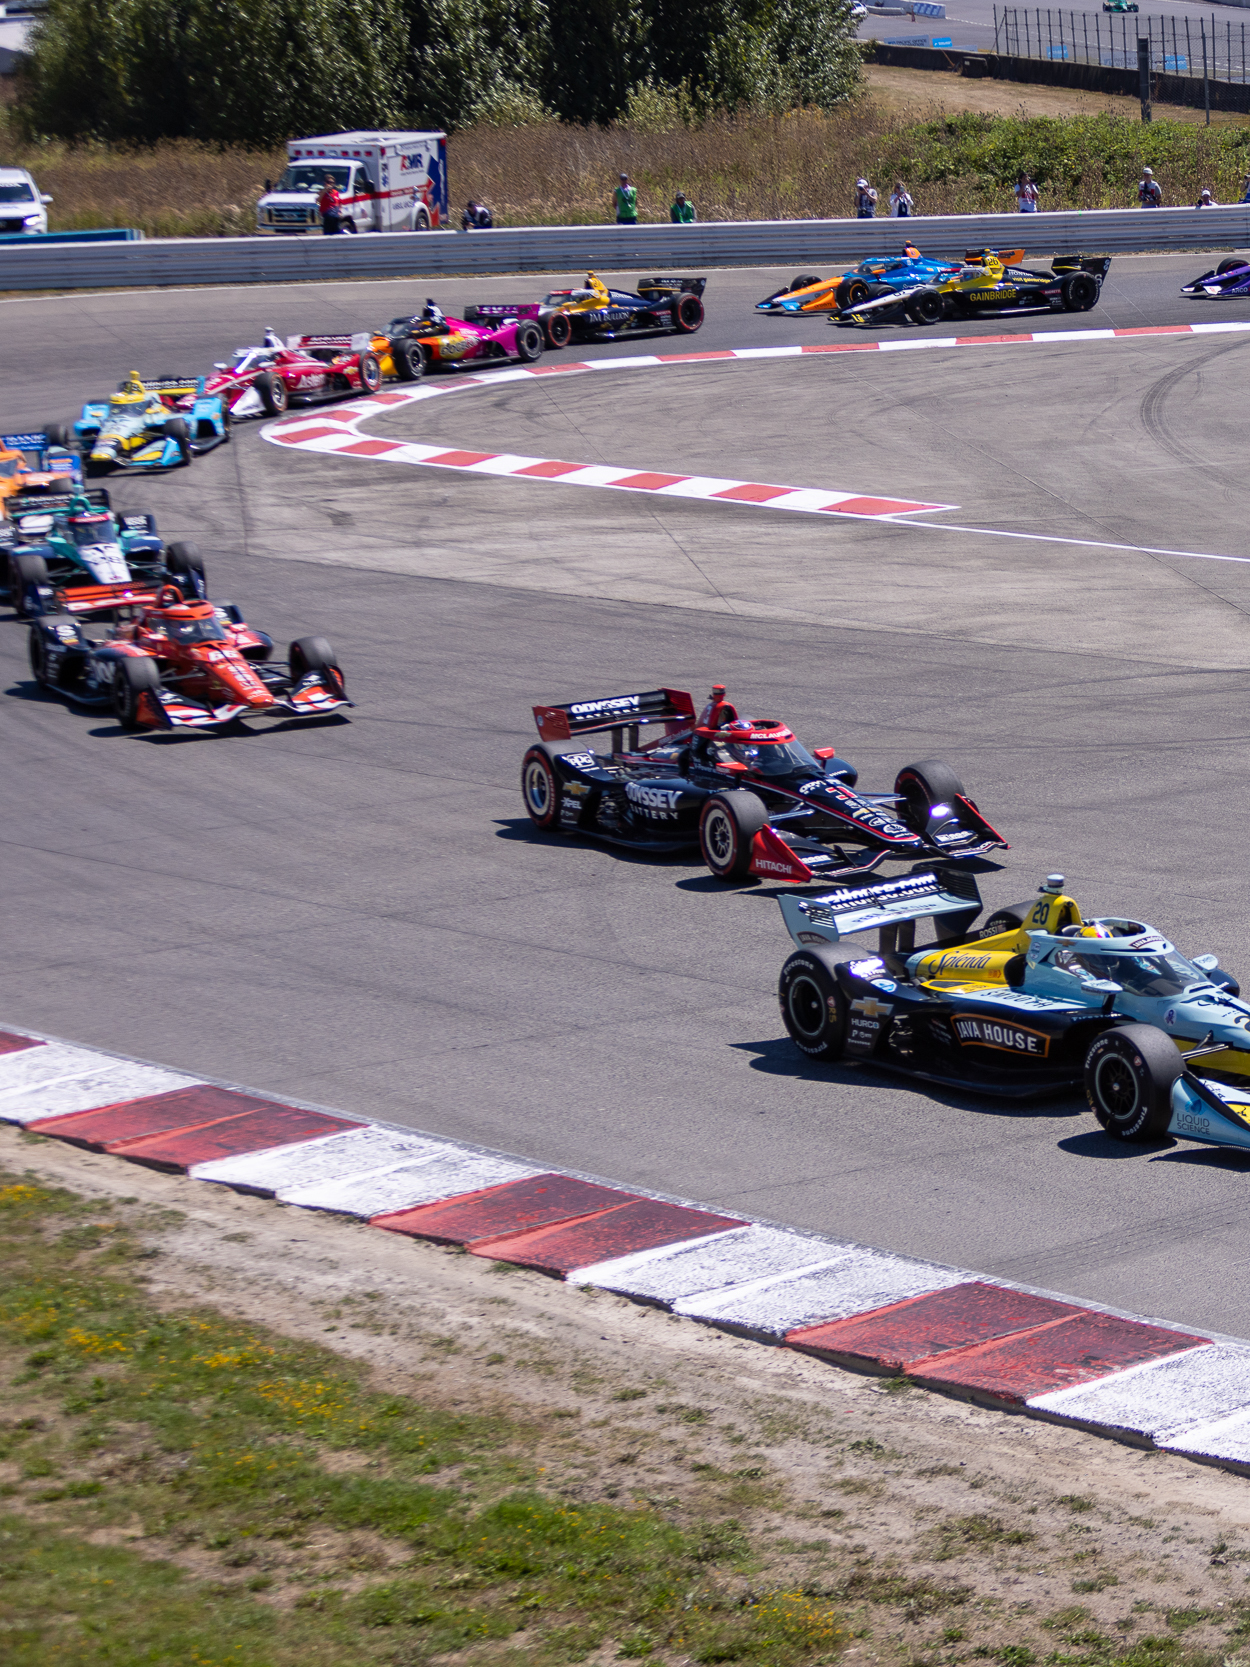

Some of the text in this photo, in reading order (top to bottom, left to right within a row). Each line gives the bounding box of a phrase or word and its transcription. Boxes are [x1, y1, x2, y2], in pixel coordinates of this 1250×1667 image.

[988, 258, 999, 266] 26
[970, 289, 1016, 302] GAINBRIDGE
[626, 782, 683, 809] ODYSSEY
[755, 858, 792, 874] HITACHI
[1032, 901, 1050, 925] 20
[979, 926, 998, 939] ROSSI
[784, 960, 814, 976] Firestone
[928, 950, 992, 976] Splenda
[851, 1018, 880, 1029] HURCO
[956, 1021, 1038, 1052] JAVA HOUSE
[1085, 1038, 1109, 1069] Firestone
[1122, 1106, 1148, 1136] Firestone
[1176, 1112, 1210, 1128] LIQUID
[1176, 1122, 1210, 1136] SCIENCE
